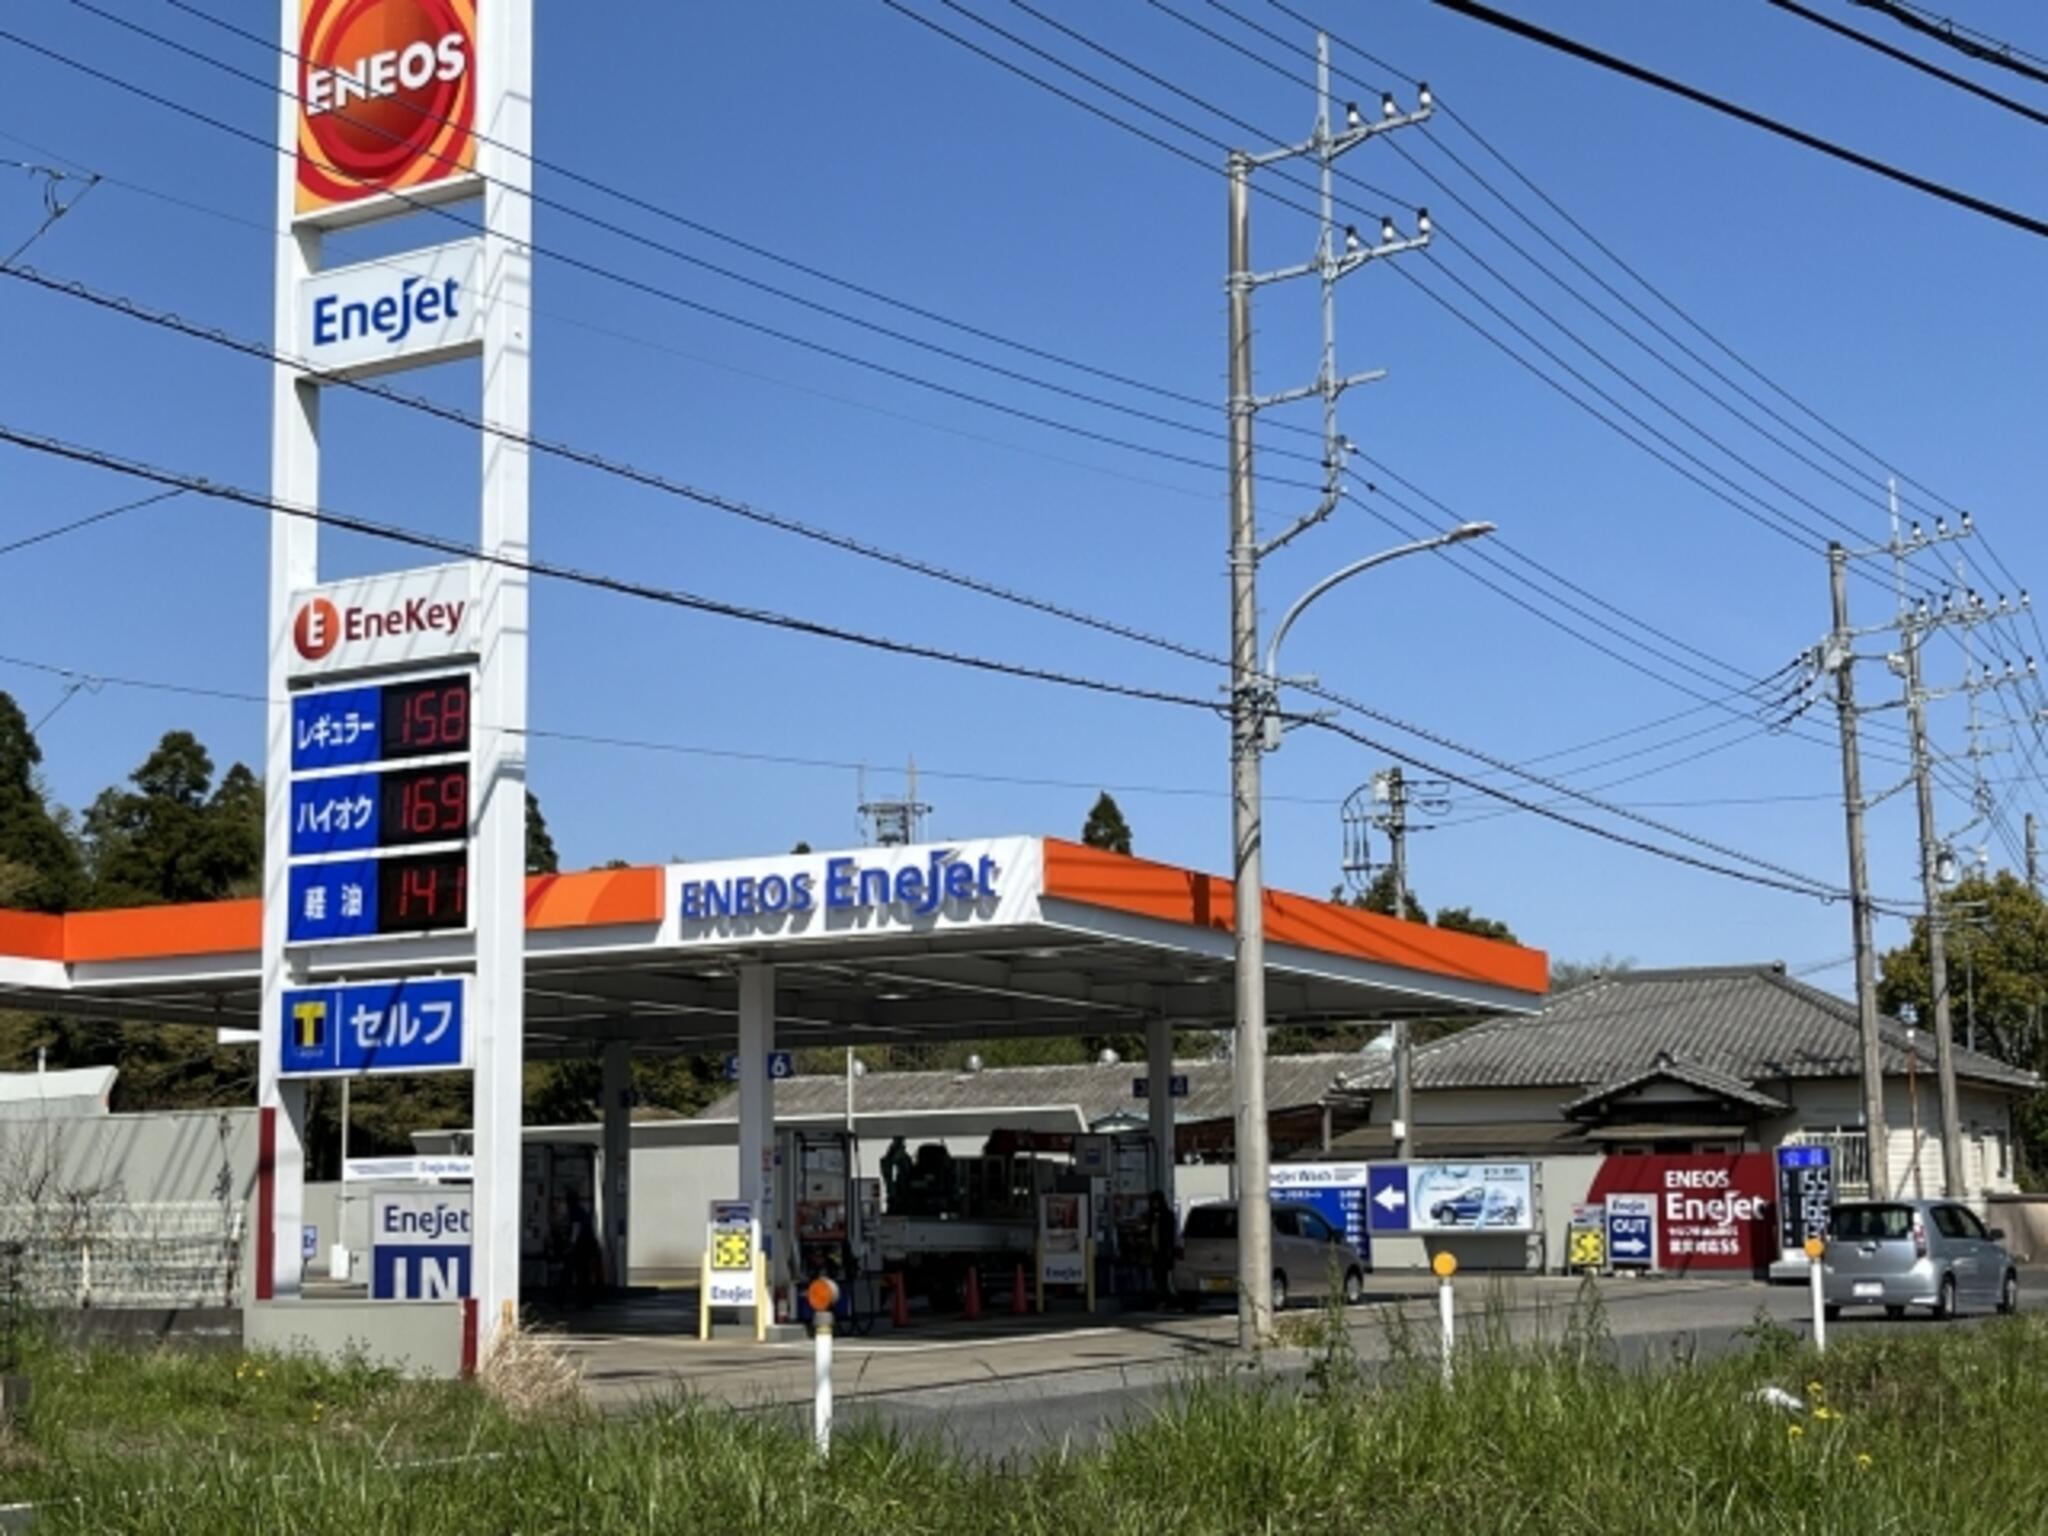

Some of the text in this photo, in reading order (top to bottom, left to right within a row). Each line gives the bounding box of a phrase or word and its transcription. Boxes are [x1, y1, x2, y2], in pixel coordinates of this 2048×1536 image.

[306, 33, 466, 116] ENEOS
[345, 598, 465, 641] EneKey
[297, 712, 376, 750] レギュラー
[403, 688, 467, 746] 158
[297, 794, 374, 834] ハイオク
[402, 774, 466, 833] 169
[399, 866, 466, 917] 141
[679, 872, 813, 920] ENEOS
[349, 1001, 453, 1049] セルフ
[771, 1055, 787, 1077] 6
[1664, 1170, 1730, 1188] ENEOS
[1611, 1218, 1647, 1234] OUT
[393, 1256, 460, 1300] IN
